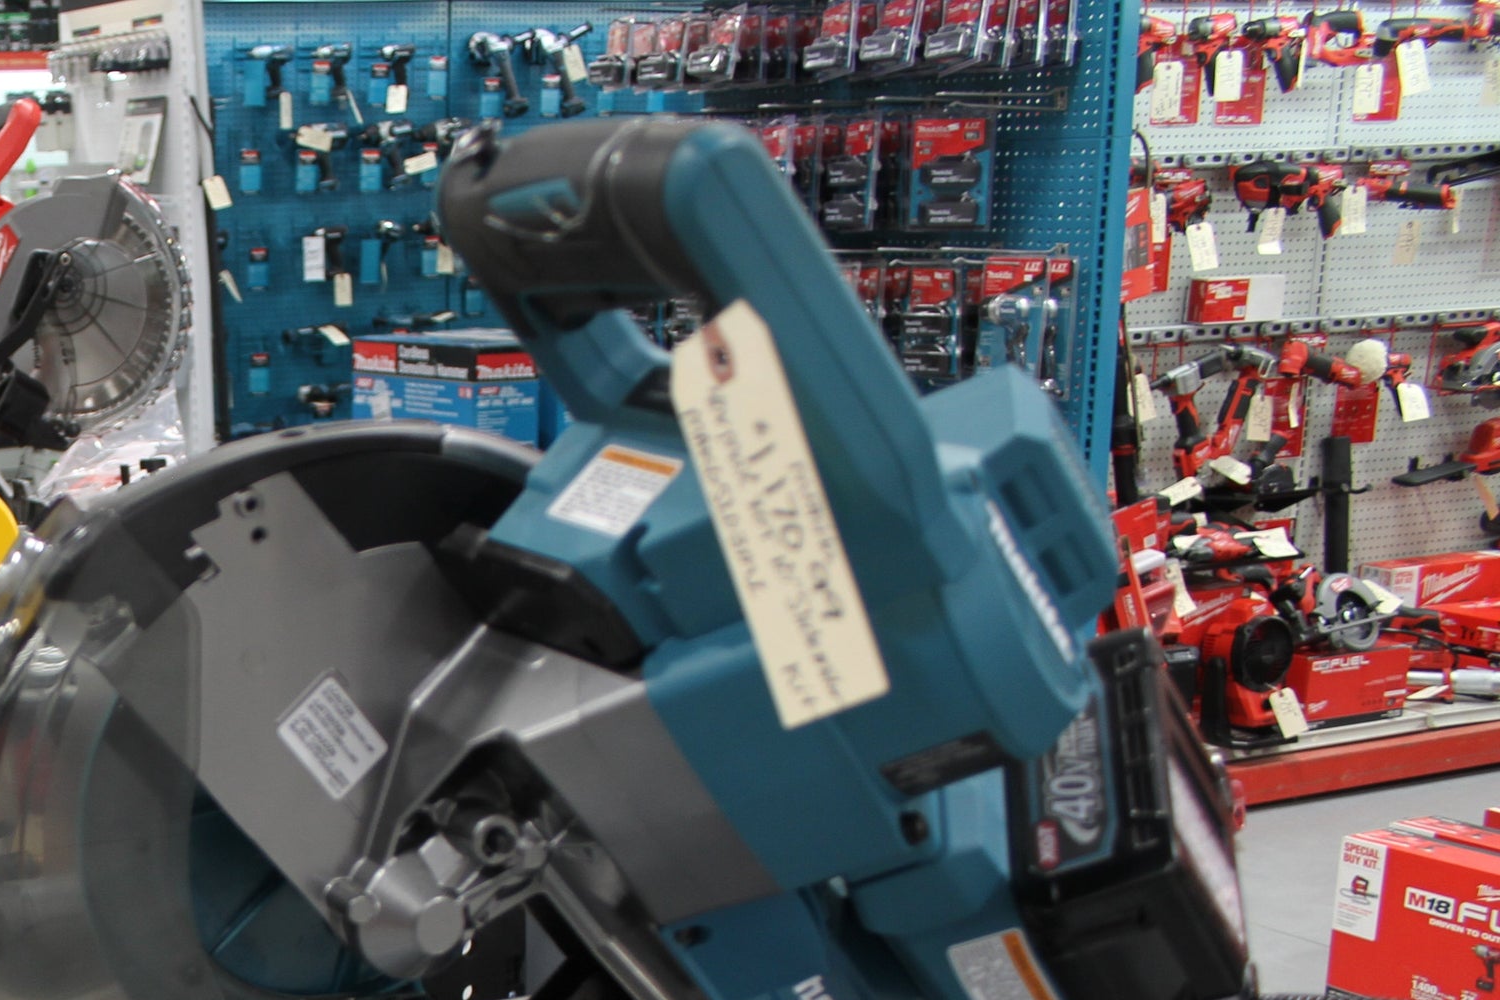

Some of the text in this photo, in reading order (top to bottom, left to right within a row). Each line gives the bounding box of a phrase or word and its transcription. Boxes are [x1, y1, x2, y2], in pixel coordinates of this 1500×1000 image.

[1344, 842, 1380, 860] SPECIAL
[1343, 853, 1378, 869] BUY KIT
[1407, 892, 1451, 915] M18
